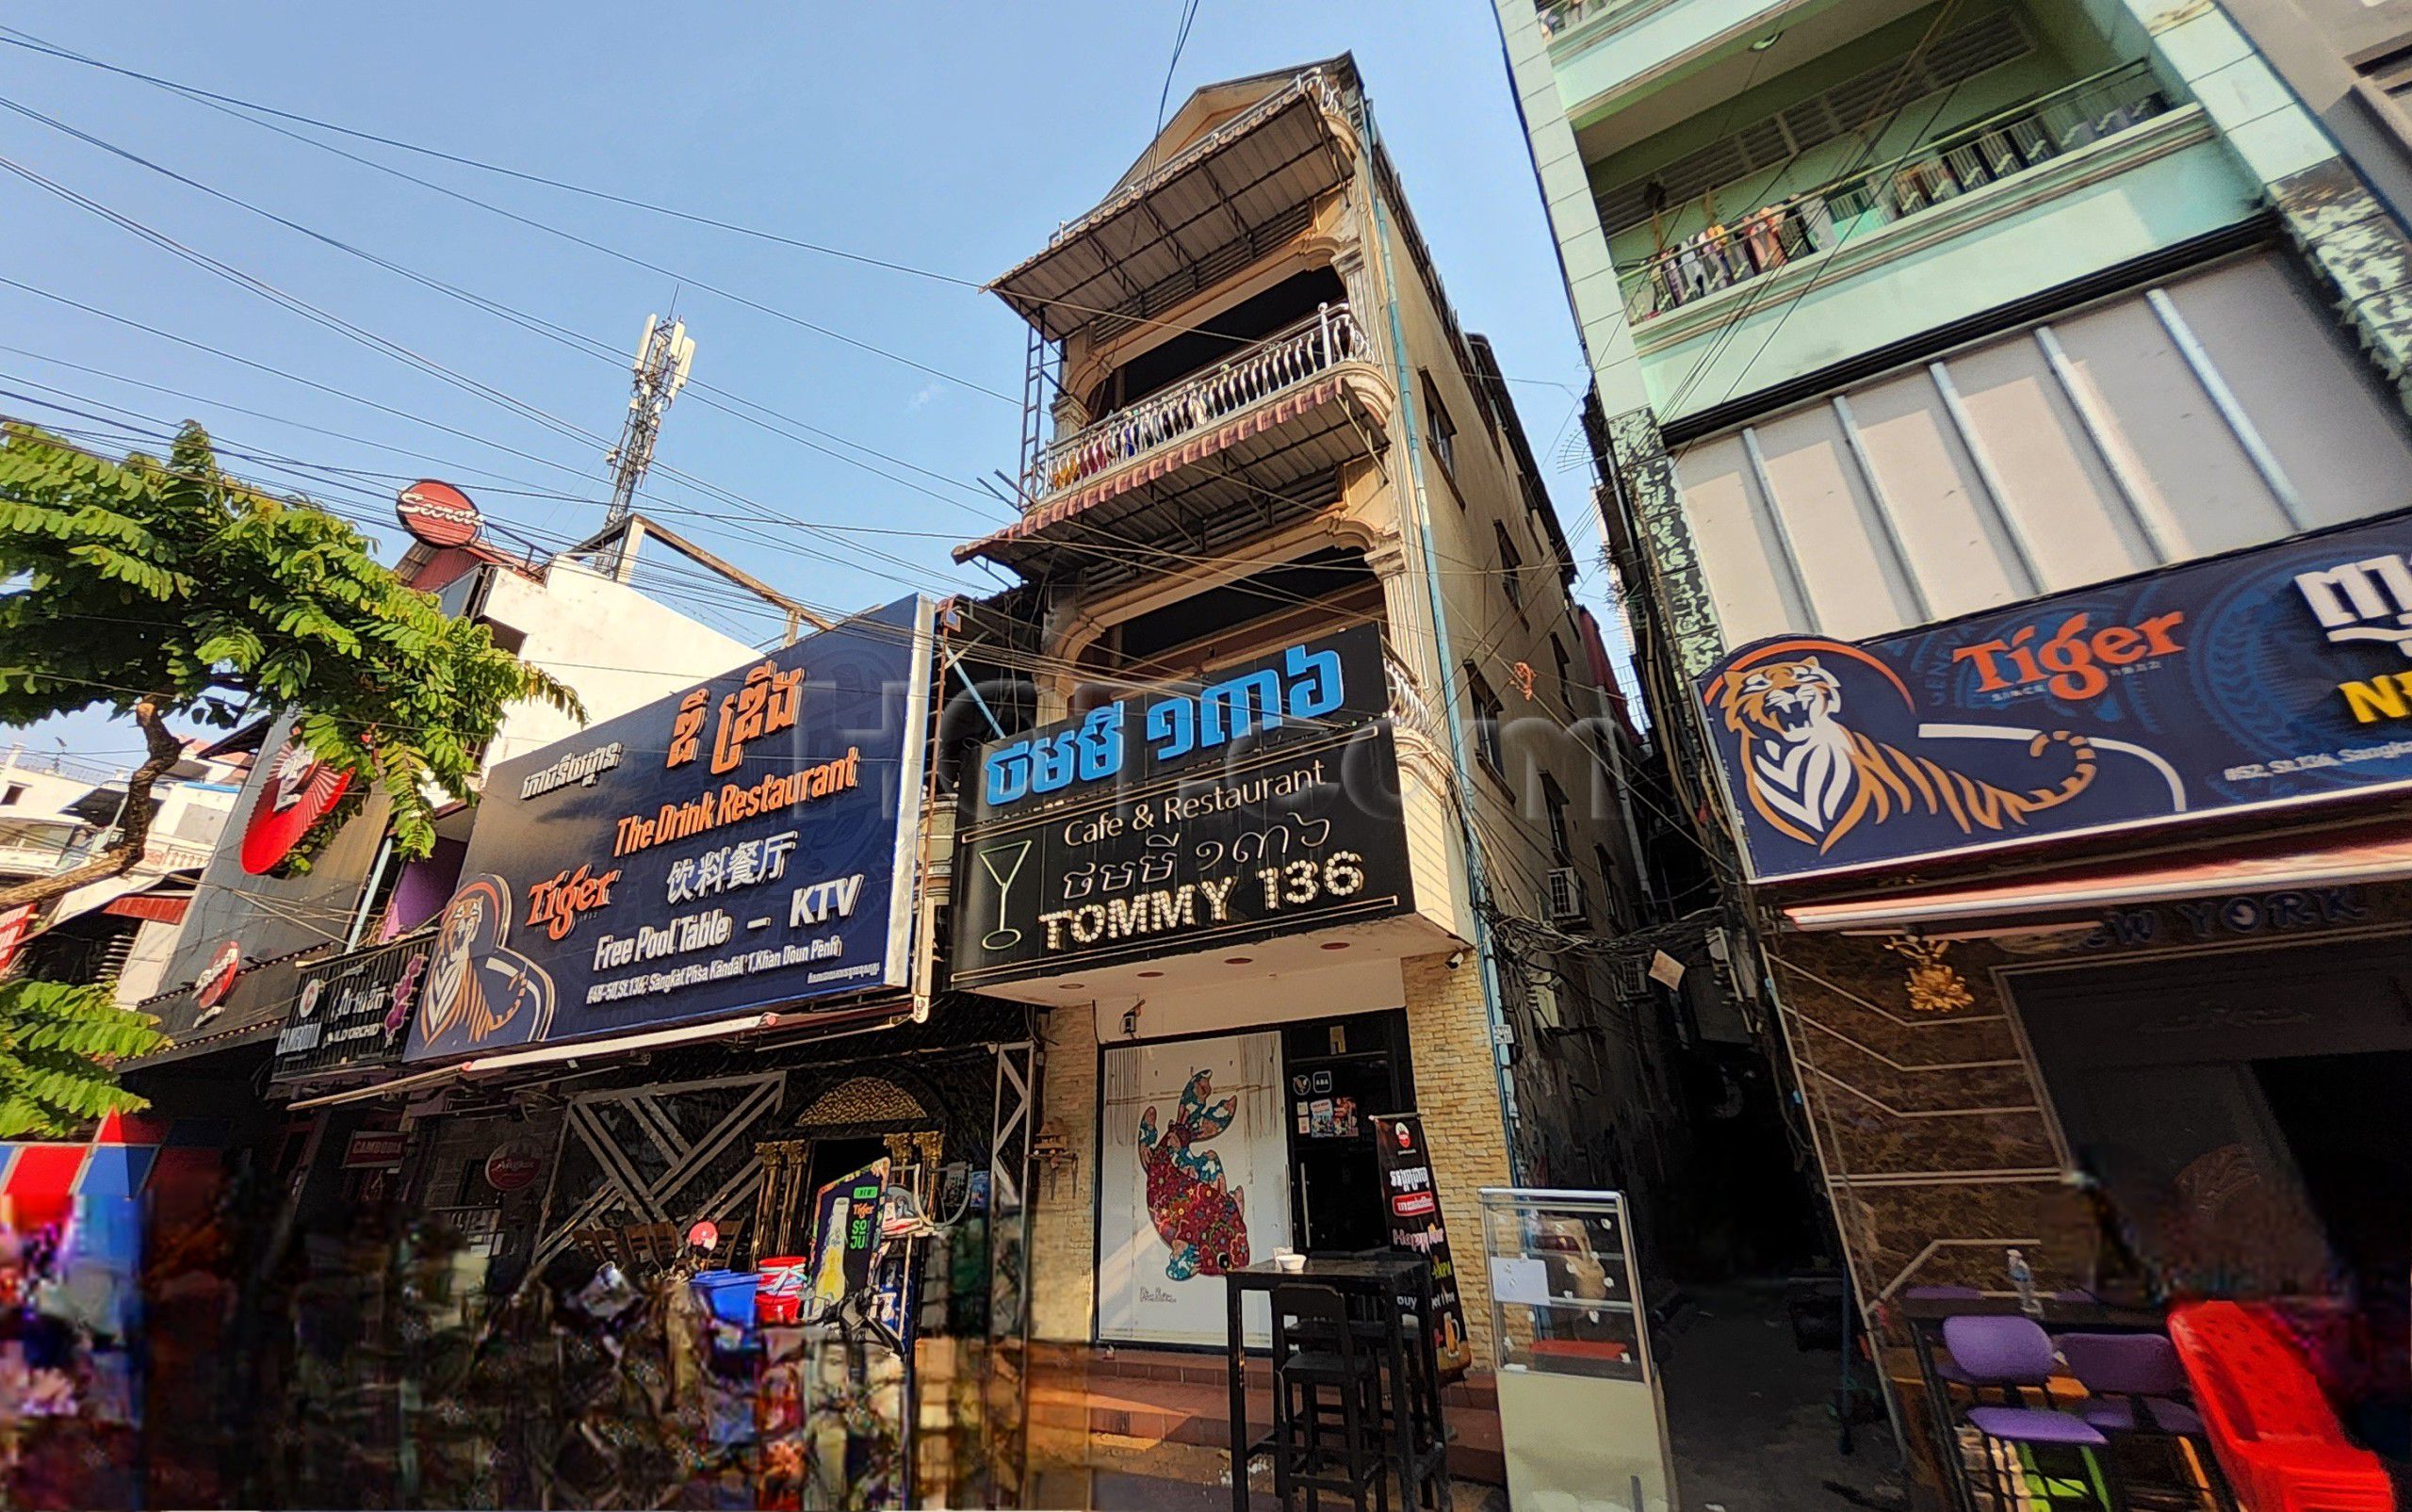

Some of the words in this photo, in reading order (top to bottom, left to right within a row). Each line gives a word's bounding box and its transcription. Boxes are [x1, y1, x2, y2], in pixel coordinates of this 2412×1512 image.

[1952, 611, 2185, 700] Tiger
[613, 815, 656, 857] The
[654, 792, 716, 845] Drink
[716, 746, 861, 826] Restaurant
[1065, 811, 1124, 847] Cafe
[1132, 805, 1154, 830] &
[1165, 759, 1327, 821] Restaurant
[525, 864, 622, 940] Tiger
[667, 830, 799, 905] 饮料餐厅
[1038, 875, 1239, 951] TOMMY
[1255, 850, 1364, 911] 136
[593, 935, 635, 971] Free
[634, 920, 676, 962] Pool
[677, 908, 733, 952] Table
[790, 873, 865, 928] KTV
[2175, 889, 2372, 938] YORK
[782, 944, 808, 966] Doun
[853, 1203, 874, 1219] Tiger
